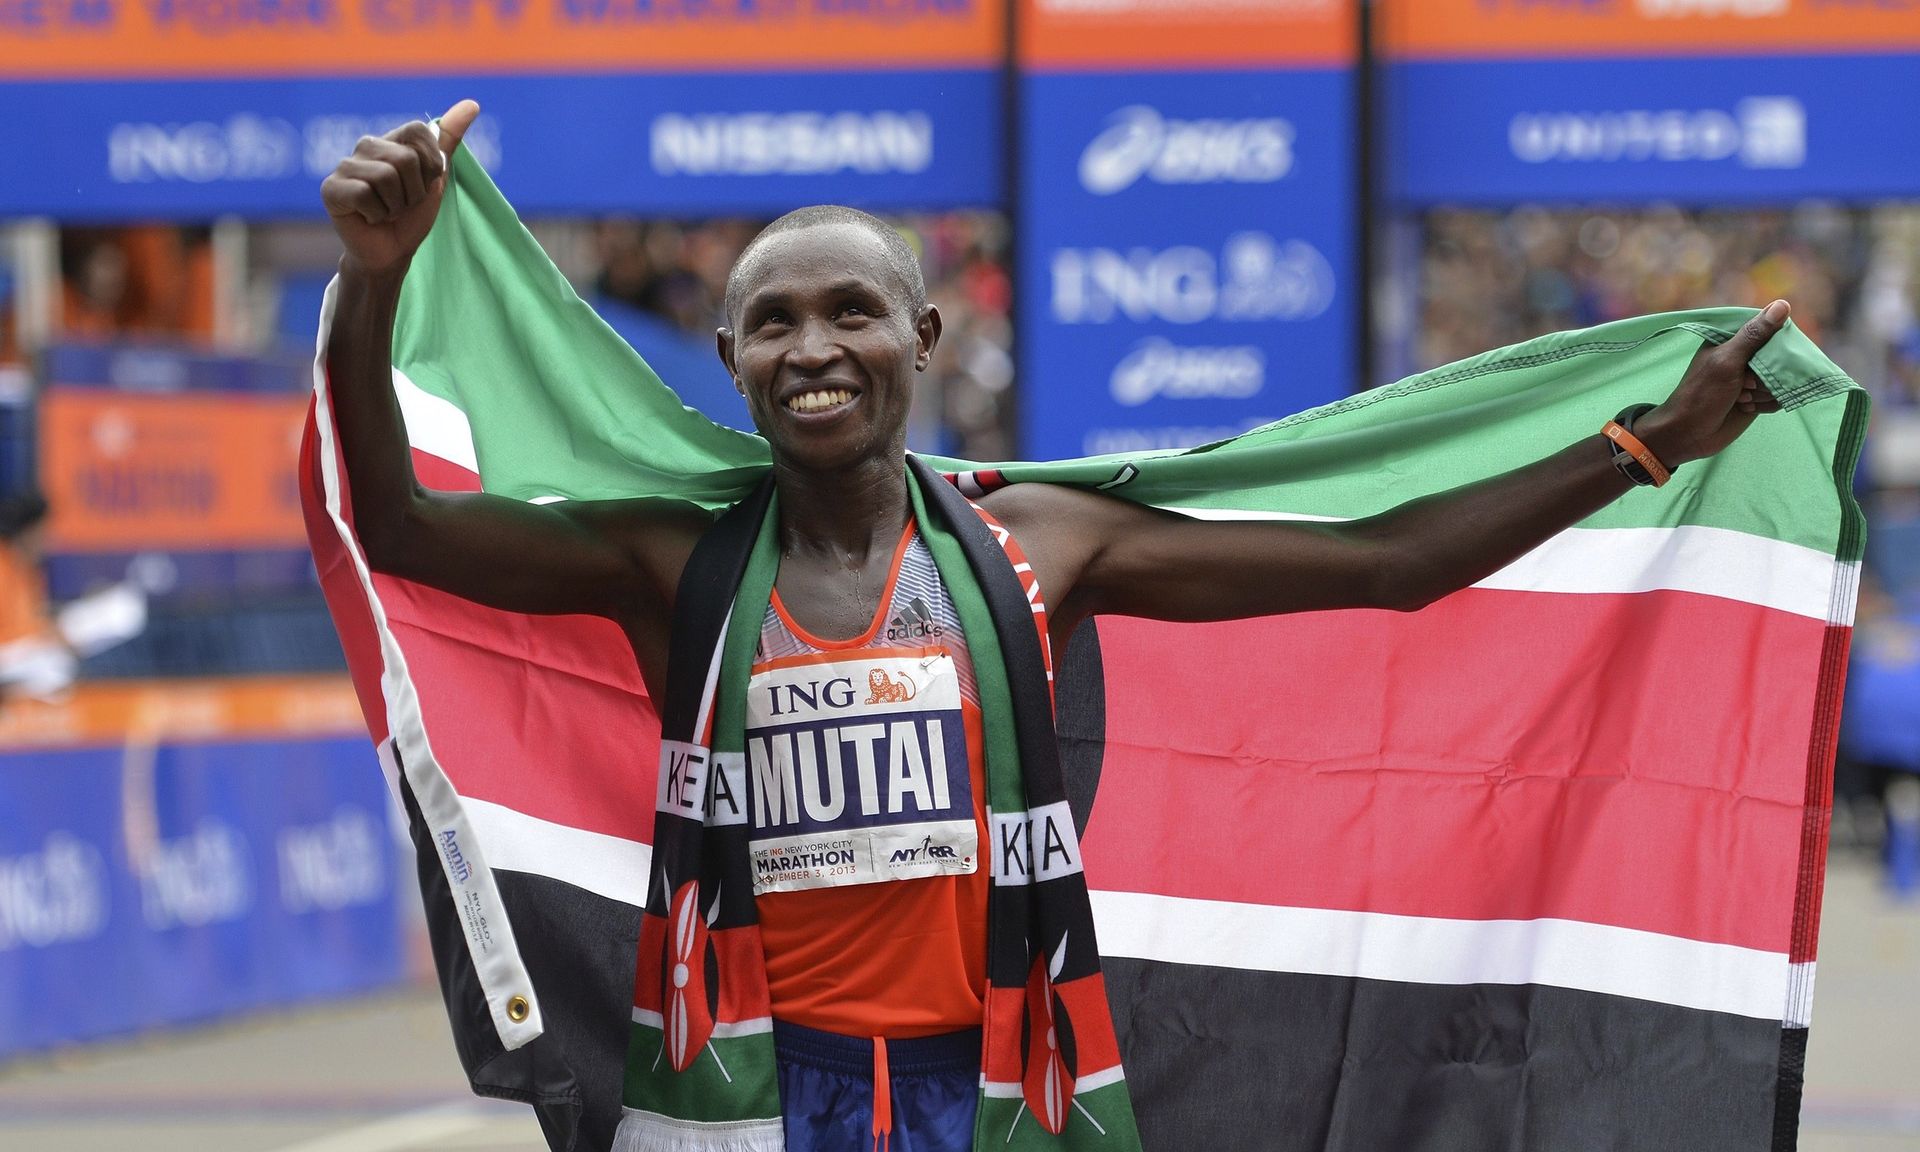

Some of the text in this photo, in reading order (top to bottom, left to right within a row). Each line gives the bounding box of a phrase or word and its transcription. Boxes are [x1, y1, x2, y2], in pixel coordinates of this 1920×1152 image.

[650, 112, 933, 175] NISSAN
[1508, 110, 1742, 162] UNITED
[1052, 246, 1219, 324] ING
[887, 622, 943, 641] adidas
[767, 678, 857, 716] ING
[667, 751, 739, 818] KEA
[747, 719, 951, 829] MUTAI
[442, 830, 468, 882] Annin
[754, 840, 853, 858] THE ING NEW YORK CITY
[756, 849, 855, 874] MARATHON
[758, 865, 856, 882] NVEMBER 3, 2013
